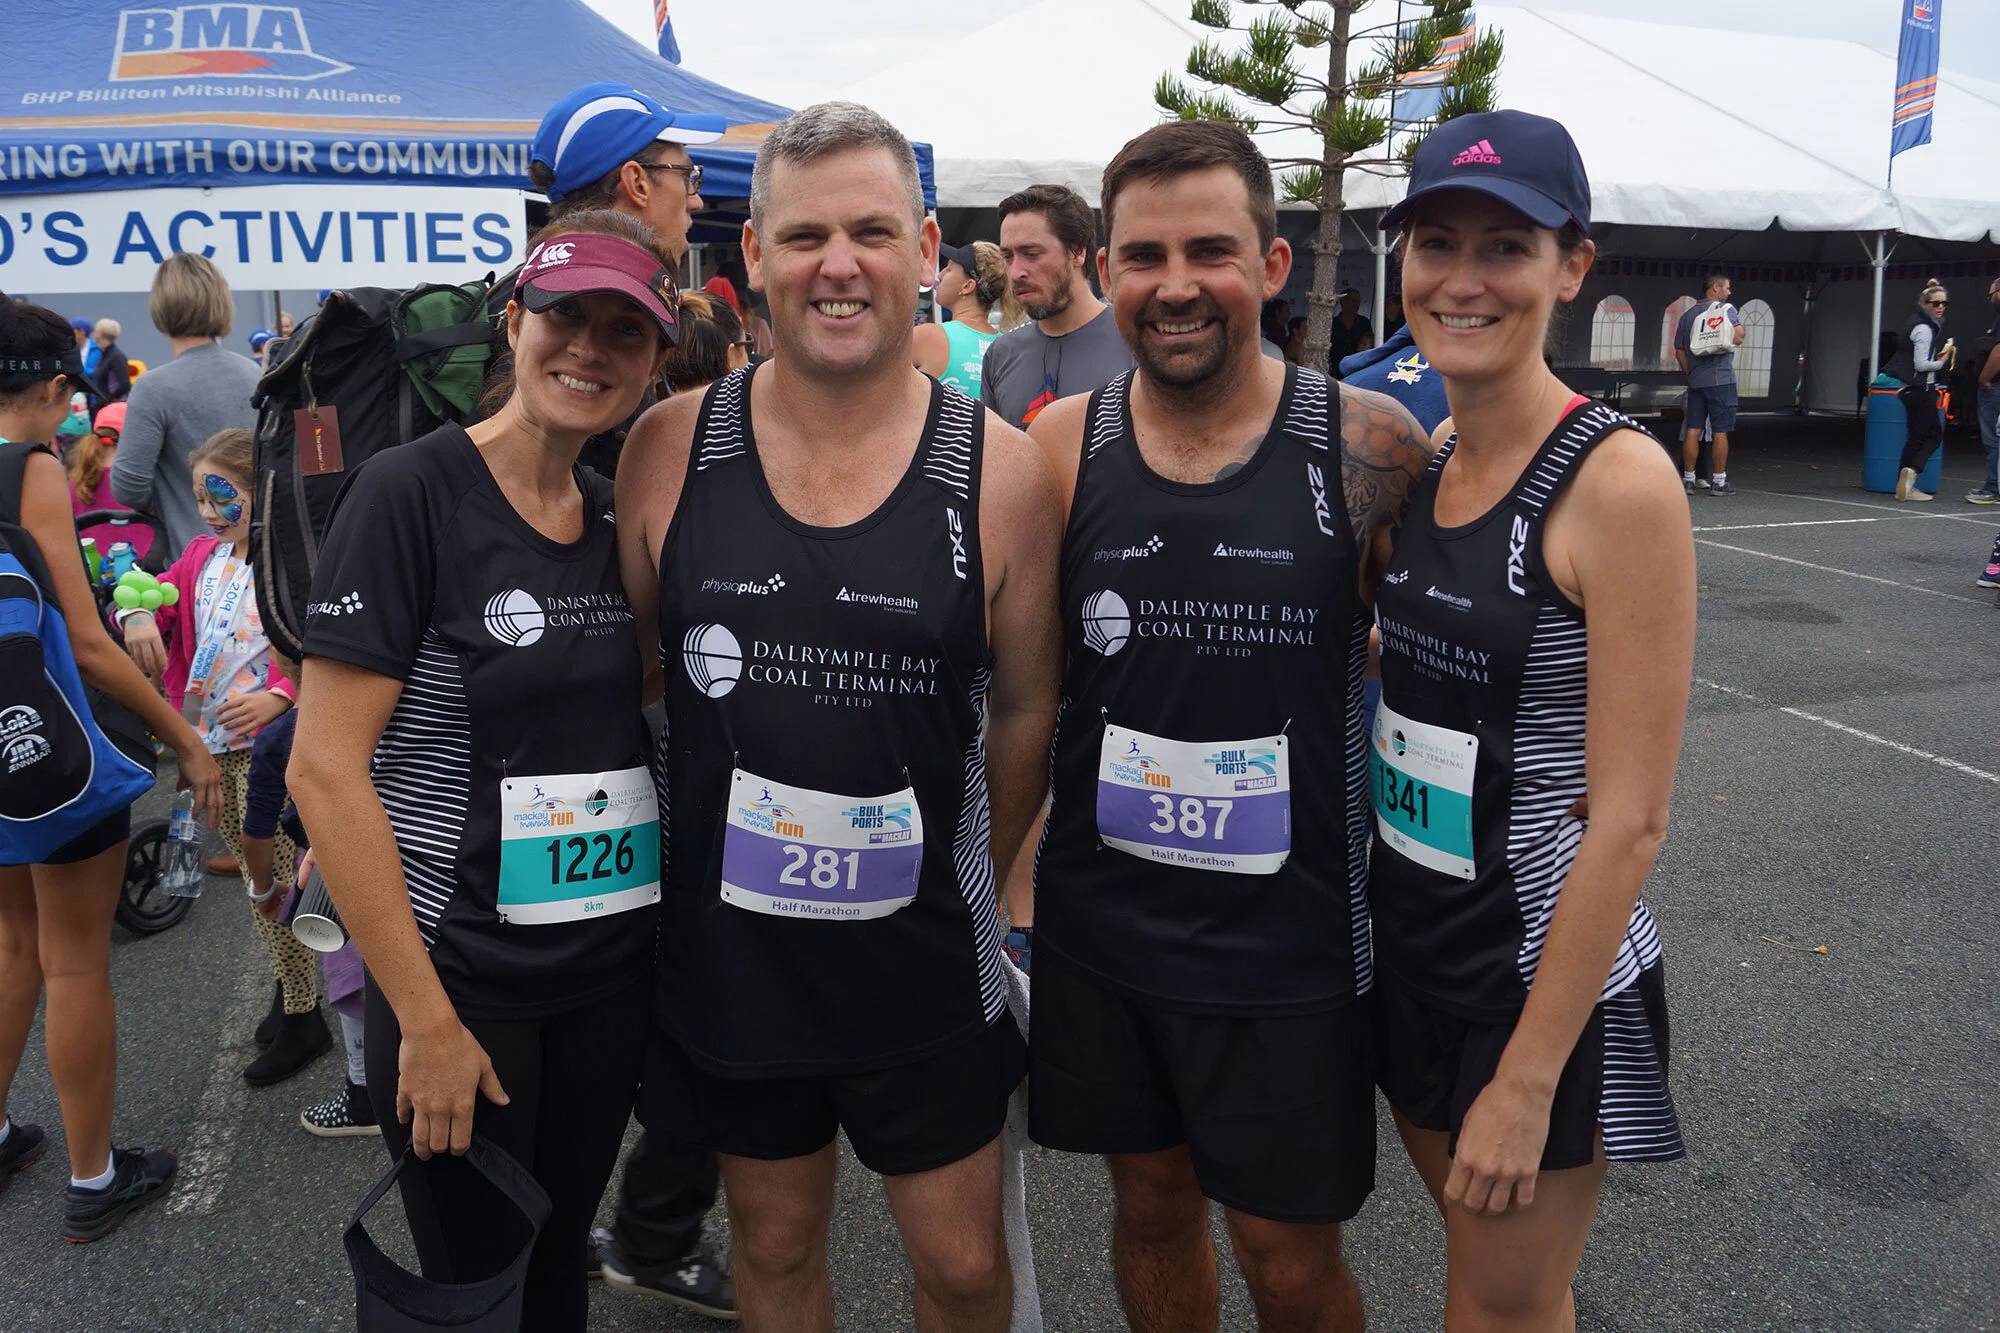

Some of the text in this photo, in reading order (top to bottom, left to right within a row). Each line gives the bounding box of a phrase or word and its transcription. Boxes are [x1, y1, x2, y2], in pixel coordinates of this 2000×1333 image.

[143, 8, 288, 50] BMA
[21, 84, 402, 105] BHP Billiton Mitsubishi Alliance
[98, 139, 214, 177] WITH
[228, 139, 317, 174] OUR
[329, 140, 534, 176] COMMUNI
[1452, 154, 1501, 166] adidas
[112, 209, 513, 266] ACTIVITIES
[1306, 462, 1335, 537] 2XU
[946, 507, 968, 580] 2XU
[1228, 546, 1294, 560] trewhealth
[1507, 514, 1530, 597] 2XU
[701, 577, 770, 595] physioplus
[851, 591, 919, 609] trewhealth
[1139, 599, 1319, 624] DALRYMPLE BAY
[1137, 621, 1316, 646] COAL TERMINAL
[1383, 616, 1491, 666] DALRYMPLE BAY
[753, 640, 941, 674] DALRYMPLE BAY
[1197, 645, 1251, 657] PTY LTD
[1383, 634, 1493, 685] COAL TERMINAL
[748, 665, 939, 696] COAL TERMINAL
[814, 694, 873, 708] PTY LTD
[1221, 750, 1246, 762] BULK
[1215, 762, 1247, 775] PORTS
[1145, 771, 1171, 788] run
[1379, 761, 1429, 830] 1341
[513, 810, 549, 822] mackay
[551, 811, 574, 826] run
[738, 807, 774, 826] mackay
[859, 805, 884, 816] BULK
[1149, 793, 1233, 840] 387
[775, 820, 804, 838] run
[851, 816, 884, 828] PORTS
[547, 829, 634, 885] 1226
[1152, 849, 1235, 868] Half Marathon
[779, 844, 860, 890] 281
[584, 901, 604, 913] 8km
[772, 900, 861, 916] Half Marathon
